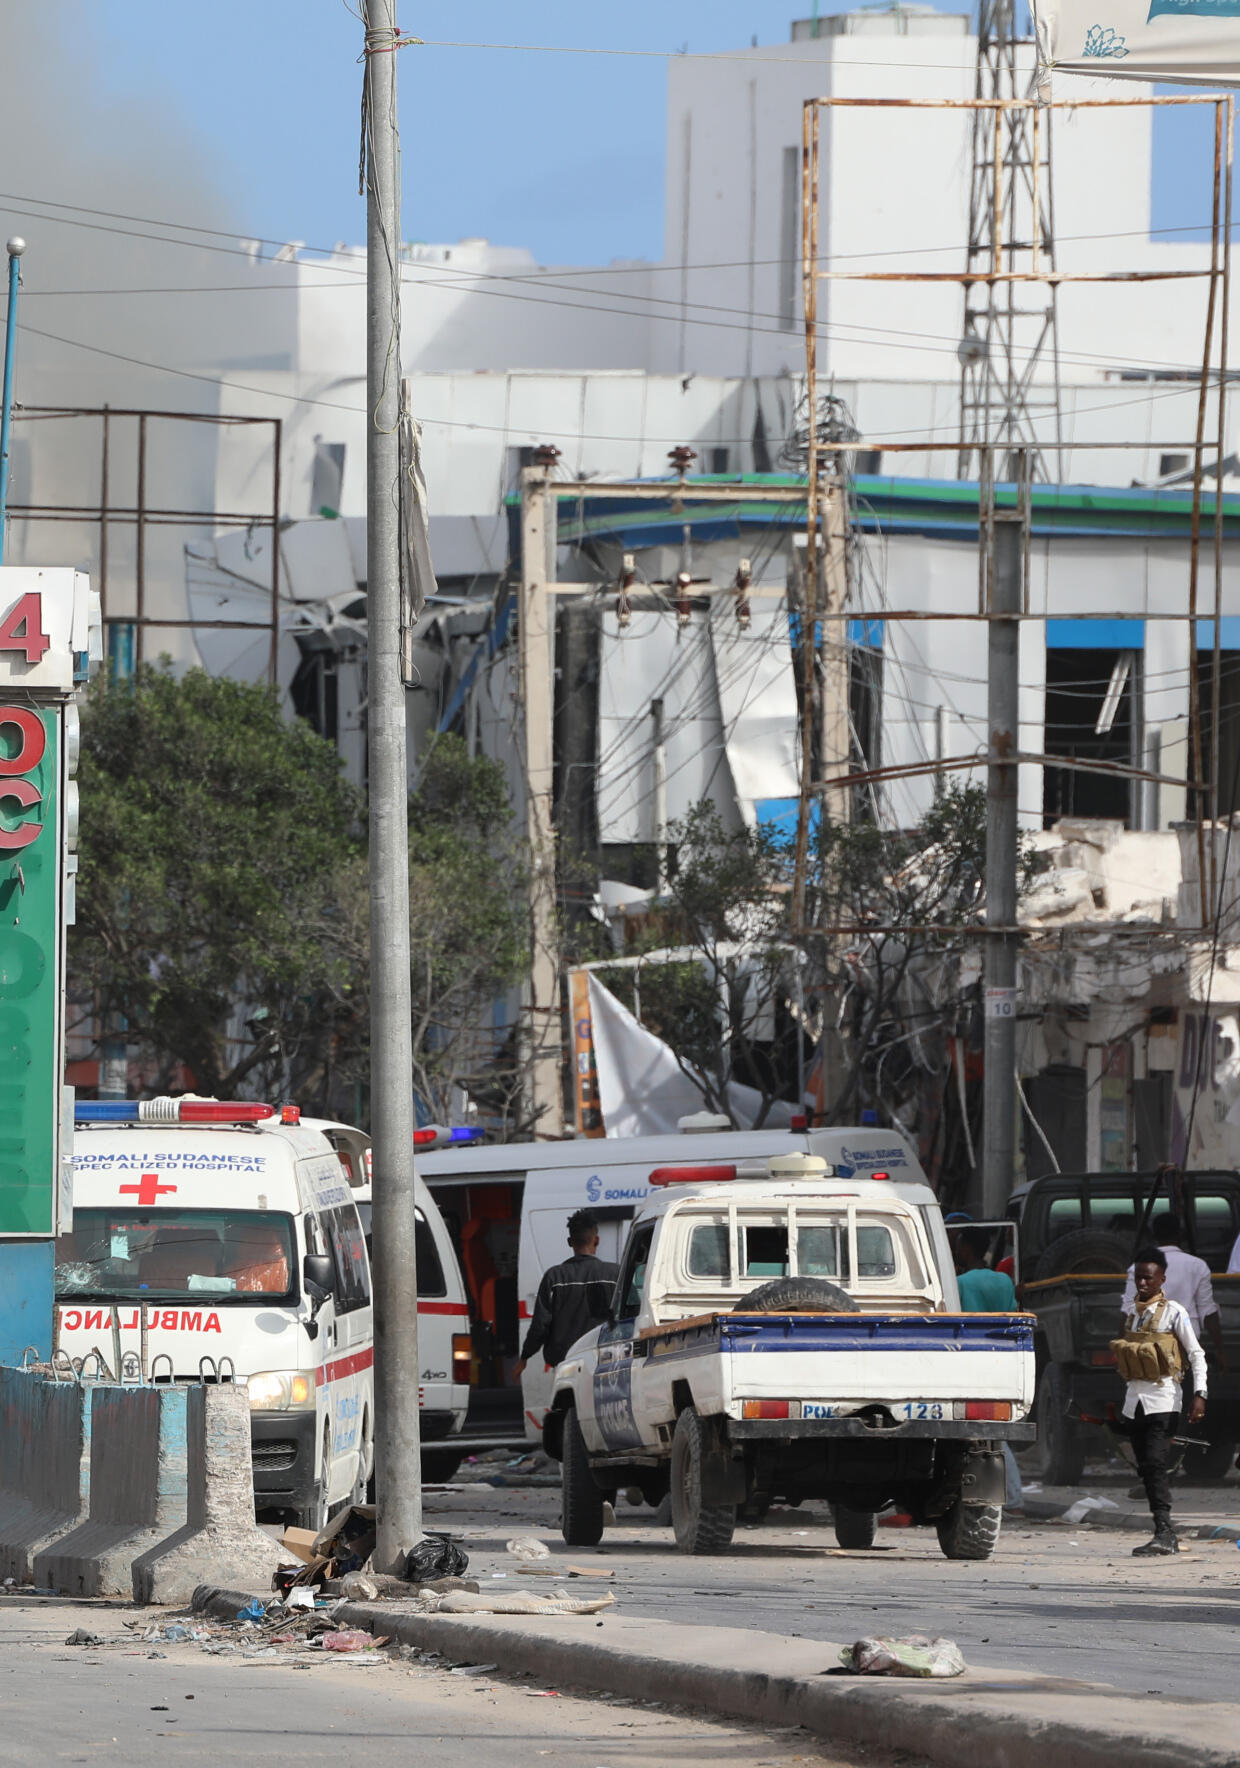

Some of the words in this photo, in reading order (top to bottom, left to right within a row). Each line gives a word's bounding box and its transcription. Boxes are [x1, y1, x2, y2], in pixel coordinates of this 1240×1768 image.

[995, 1003, 1011, 1015] 10
[70, 1154, 148, 1163] SOMALI
[154, 1153, 265, 1165] SUDANESE
[182, 1163, 265, 1173] HOSPITAL
[605, 1187, 648, 1200] SOMALI
